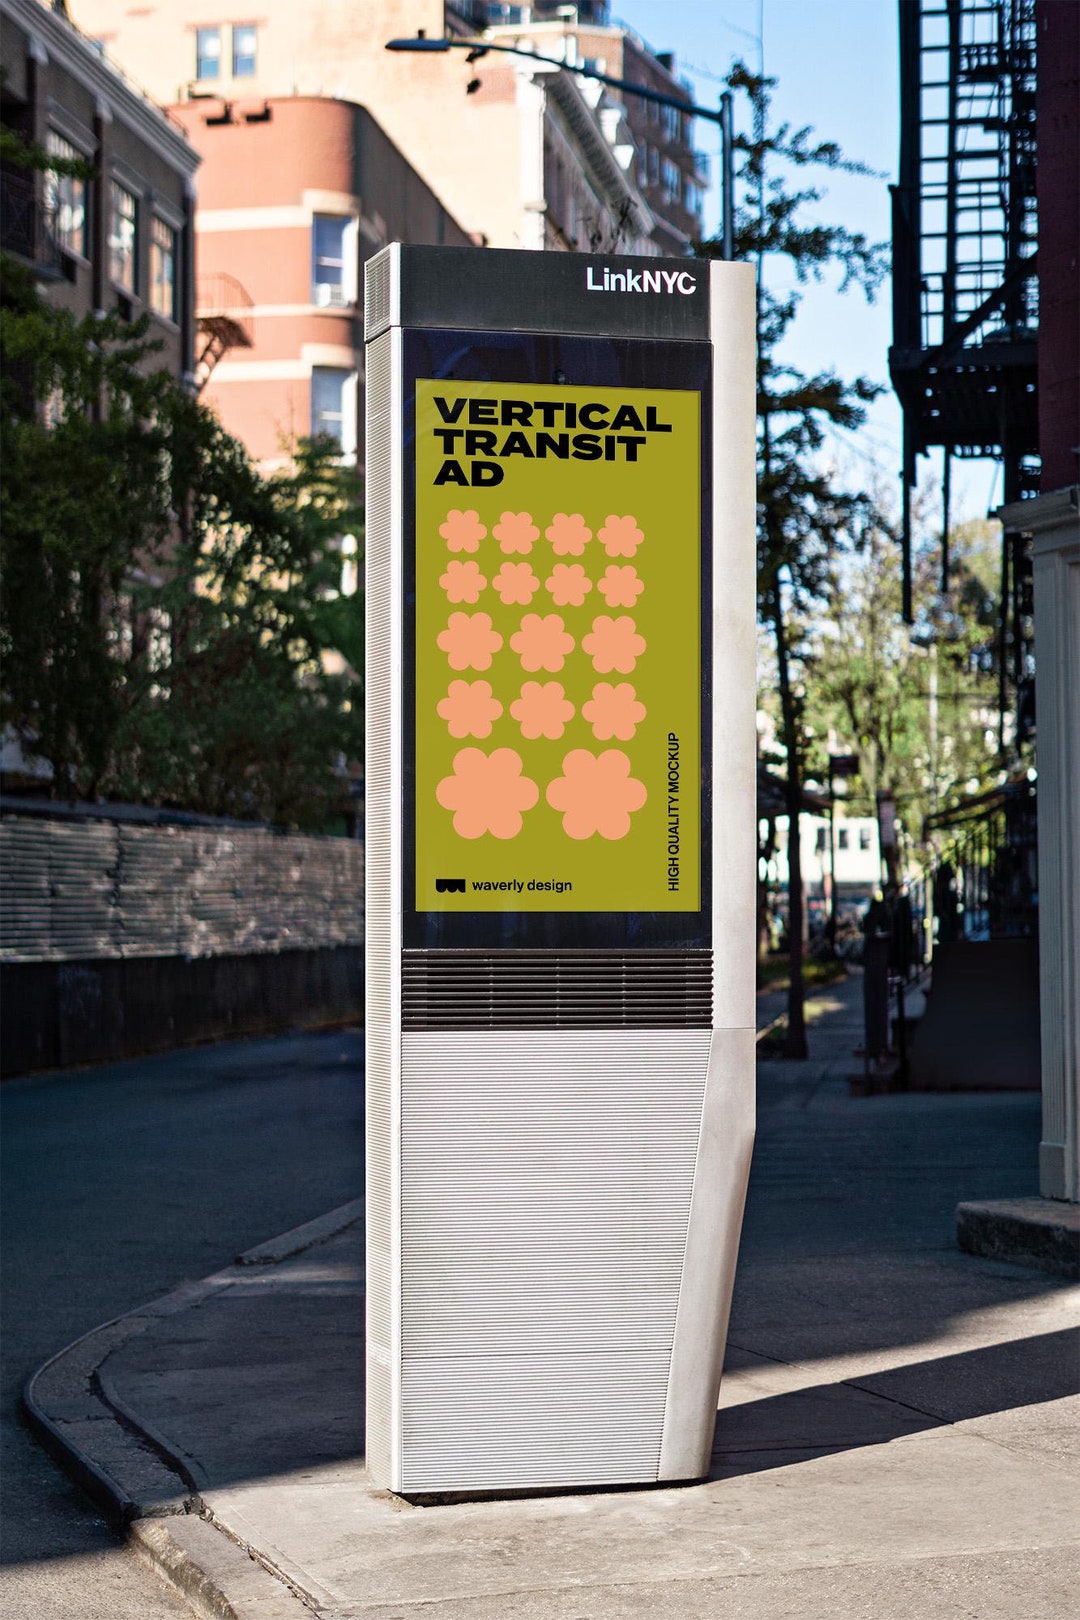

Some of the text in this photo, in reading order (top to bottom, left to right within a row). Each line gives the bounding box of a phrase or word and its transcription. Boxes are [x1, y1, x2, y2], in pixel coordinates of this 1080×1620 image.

[586, 266, 697, 295] LinkNYC
[433, 397, 673, 433] VERTICAL
[433, 428, 647, 462] TRANSIT
[433, 459, 505, 487] AD
[667, 732, 680, 892] HIGH QUALITY MOCKUP
[472, 879, 573, 893] waverly design
